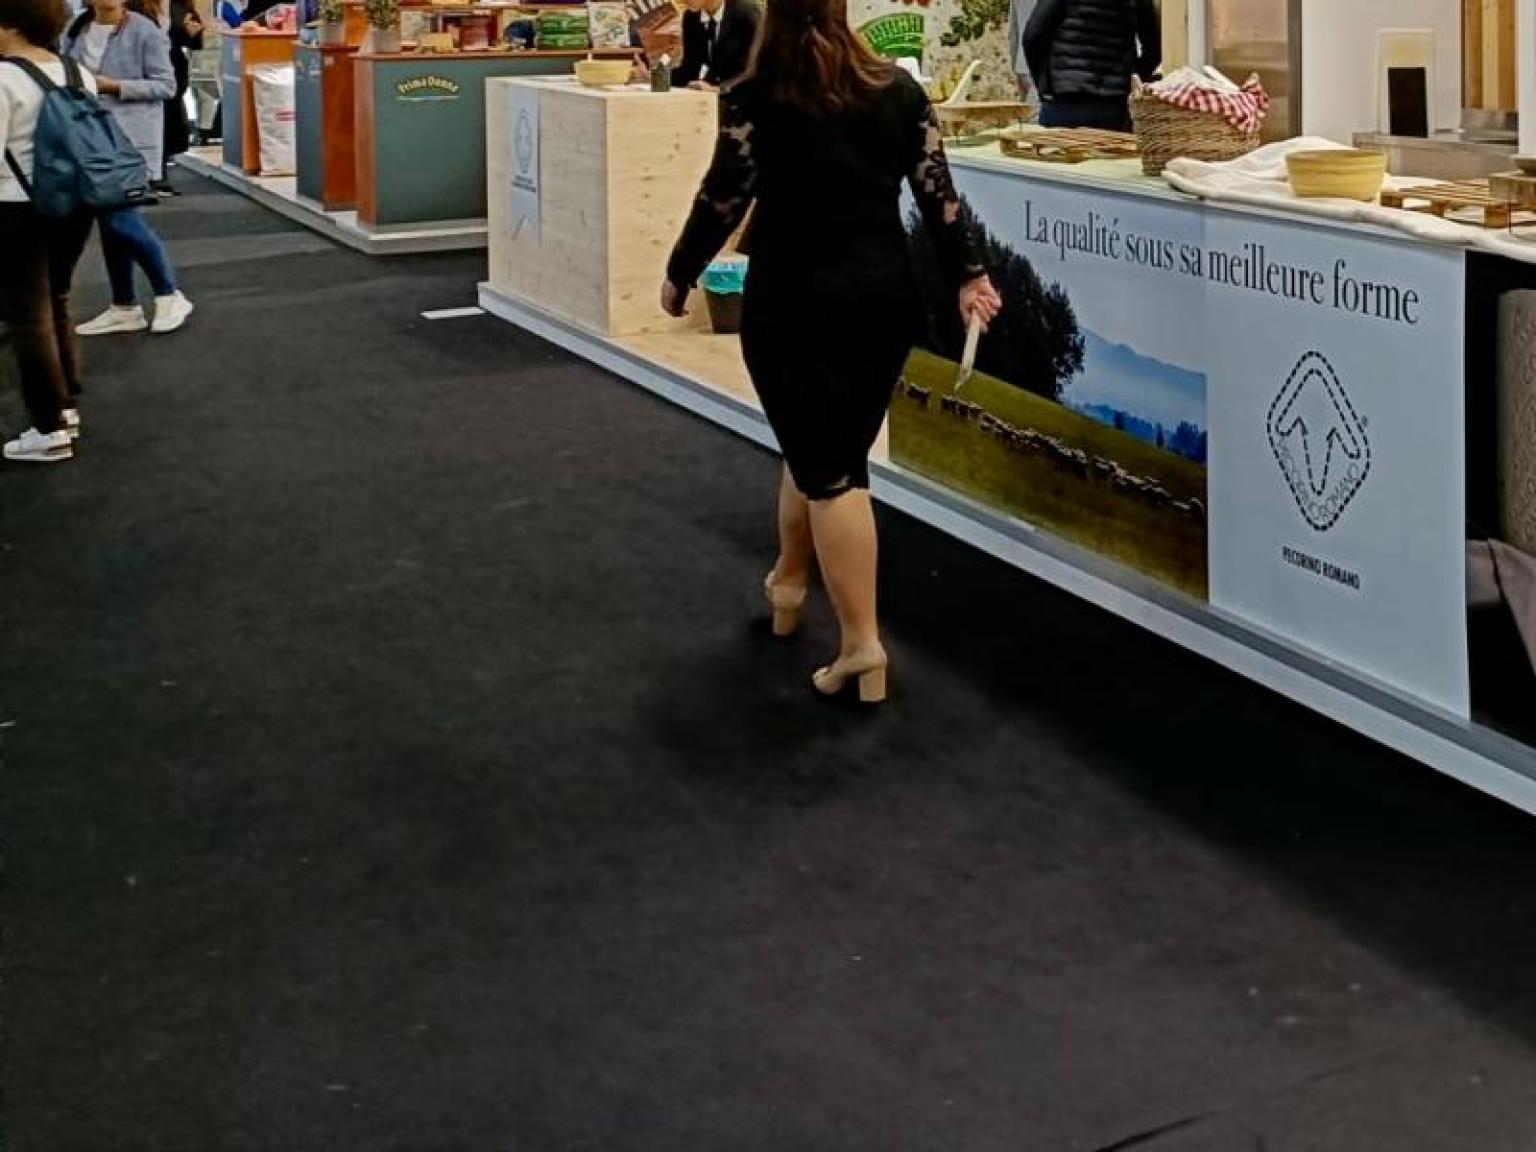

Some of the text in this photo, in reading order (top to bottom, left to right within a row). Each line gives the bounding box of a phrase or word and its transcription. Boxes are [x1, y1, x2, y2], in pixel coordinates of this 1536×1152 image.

[398, 74, 460, 94] Prima Donna
[1025, 199, 1420, 326] La qualité sous sa meilleure forme
[1282, 544, 1361, 590] PECORINO ROMANO
